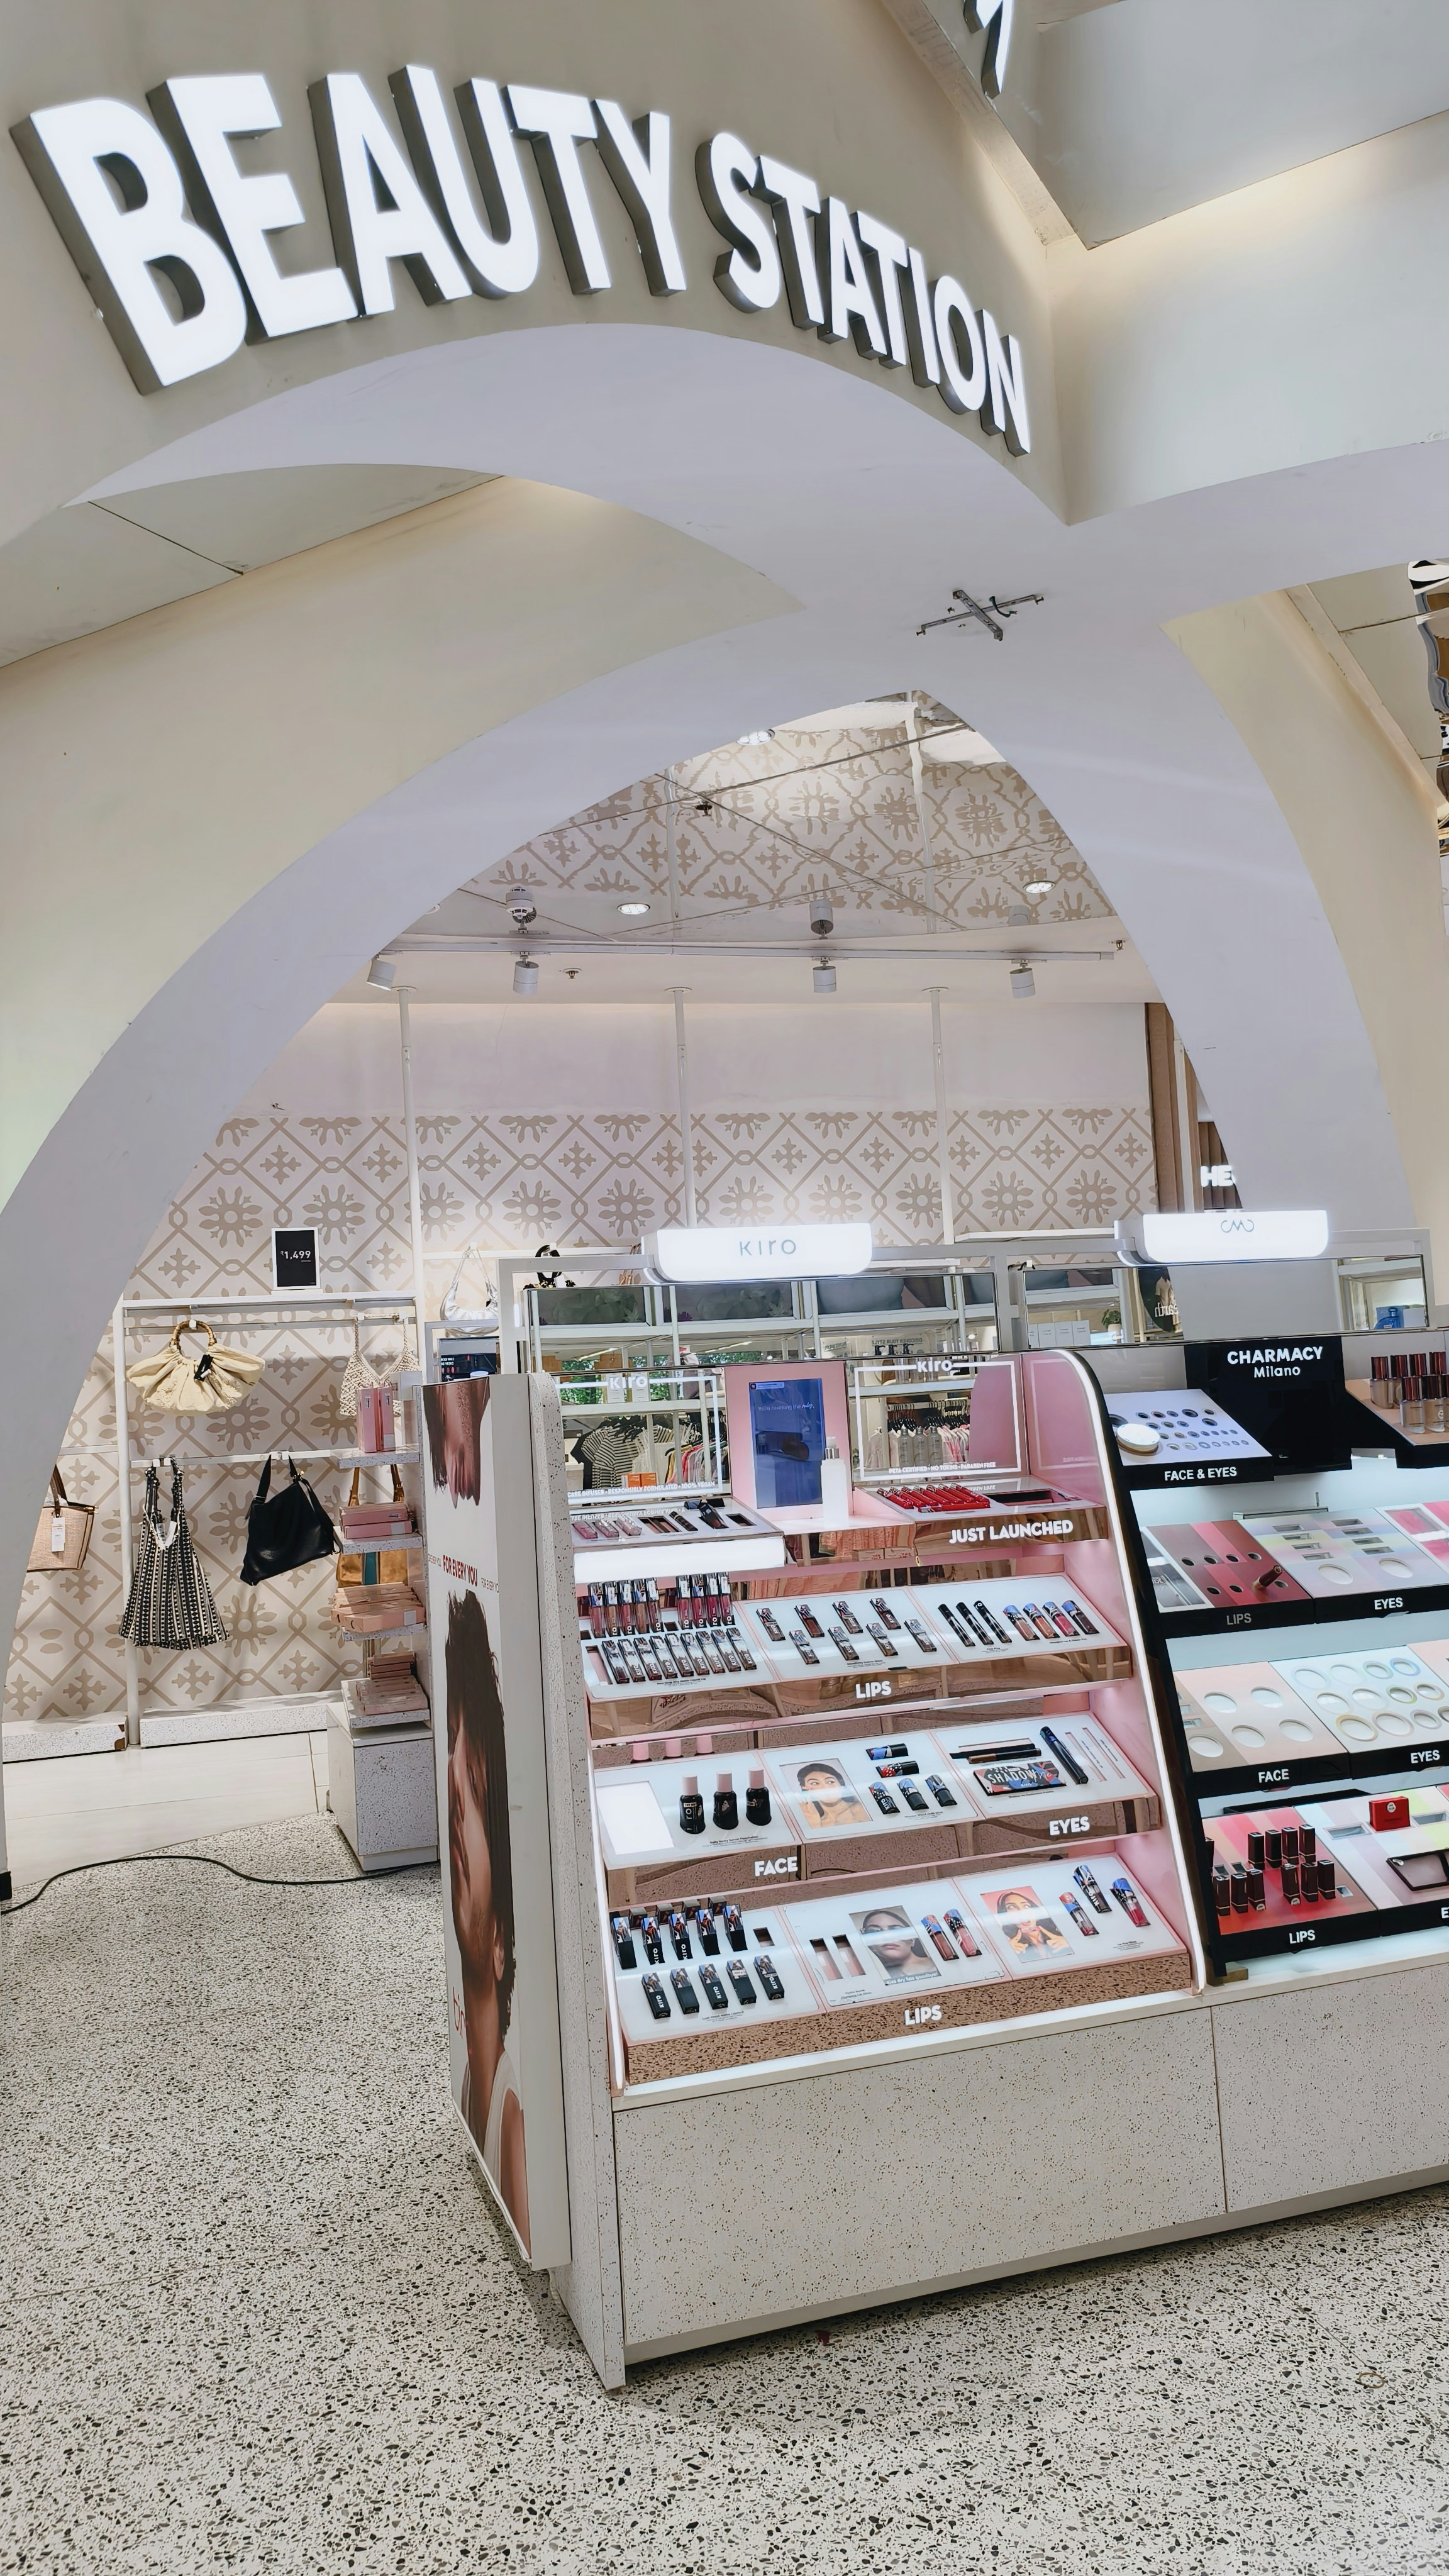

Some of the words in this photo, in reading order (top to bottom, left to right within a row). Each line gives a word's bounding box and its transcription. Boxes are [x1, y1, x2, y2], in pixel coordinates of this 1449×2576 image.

[30, 65, 687, 387] BEAUTY
[701, 131, 1031, 454] STATION
[1201, 1165, 1236, 1187] HE
[1226, 1346, 1323, 1365] CHARMACY
[1253, 1364, 1301, 1379] Milano
[1164, 1470, 1195, 1481] FACE
[1197, 1469, 1206, 1480] &
[1207, 1467, 1238, 1479] EYES
[644, 1483, 678, 1492] FORMULATED
[949, 1526, 987, 1544] JUST
[990, 1519, 1074, 1540] LAUNCHED
[443, 1554, 452, 1575] FOR
[452, 1558, 467, 1582] EVERY
[467, 1564, 478, 1587] YOU
[1374, 1597, 1404, 1611] EYES
[1226, 1613, 1252, 1626] LIPS
[855, 1680, 892, 1699] LIPS
[1410, 1750, 1441, 1763] EYES
[987, 1768, 1036, 1784] SHADOW
[1258, 1768, 1290, 1783] FACE
[1049, 1816, 1091, 1836] EYES
[754, 1856, 798, 1877] FACE
[1289, 1929, 1316, 1945] LIPS
[904, 2004, 943, 2025] LIPS
